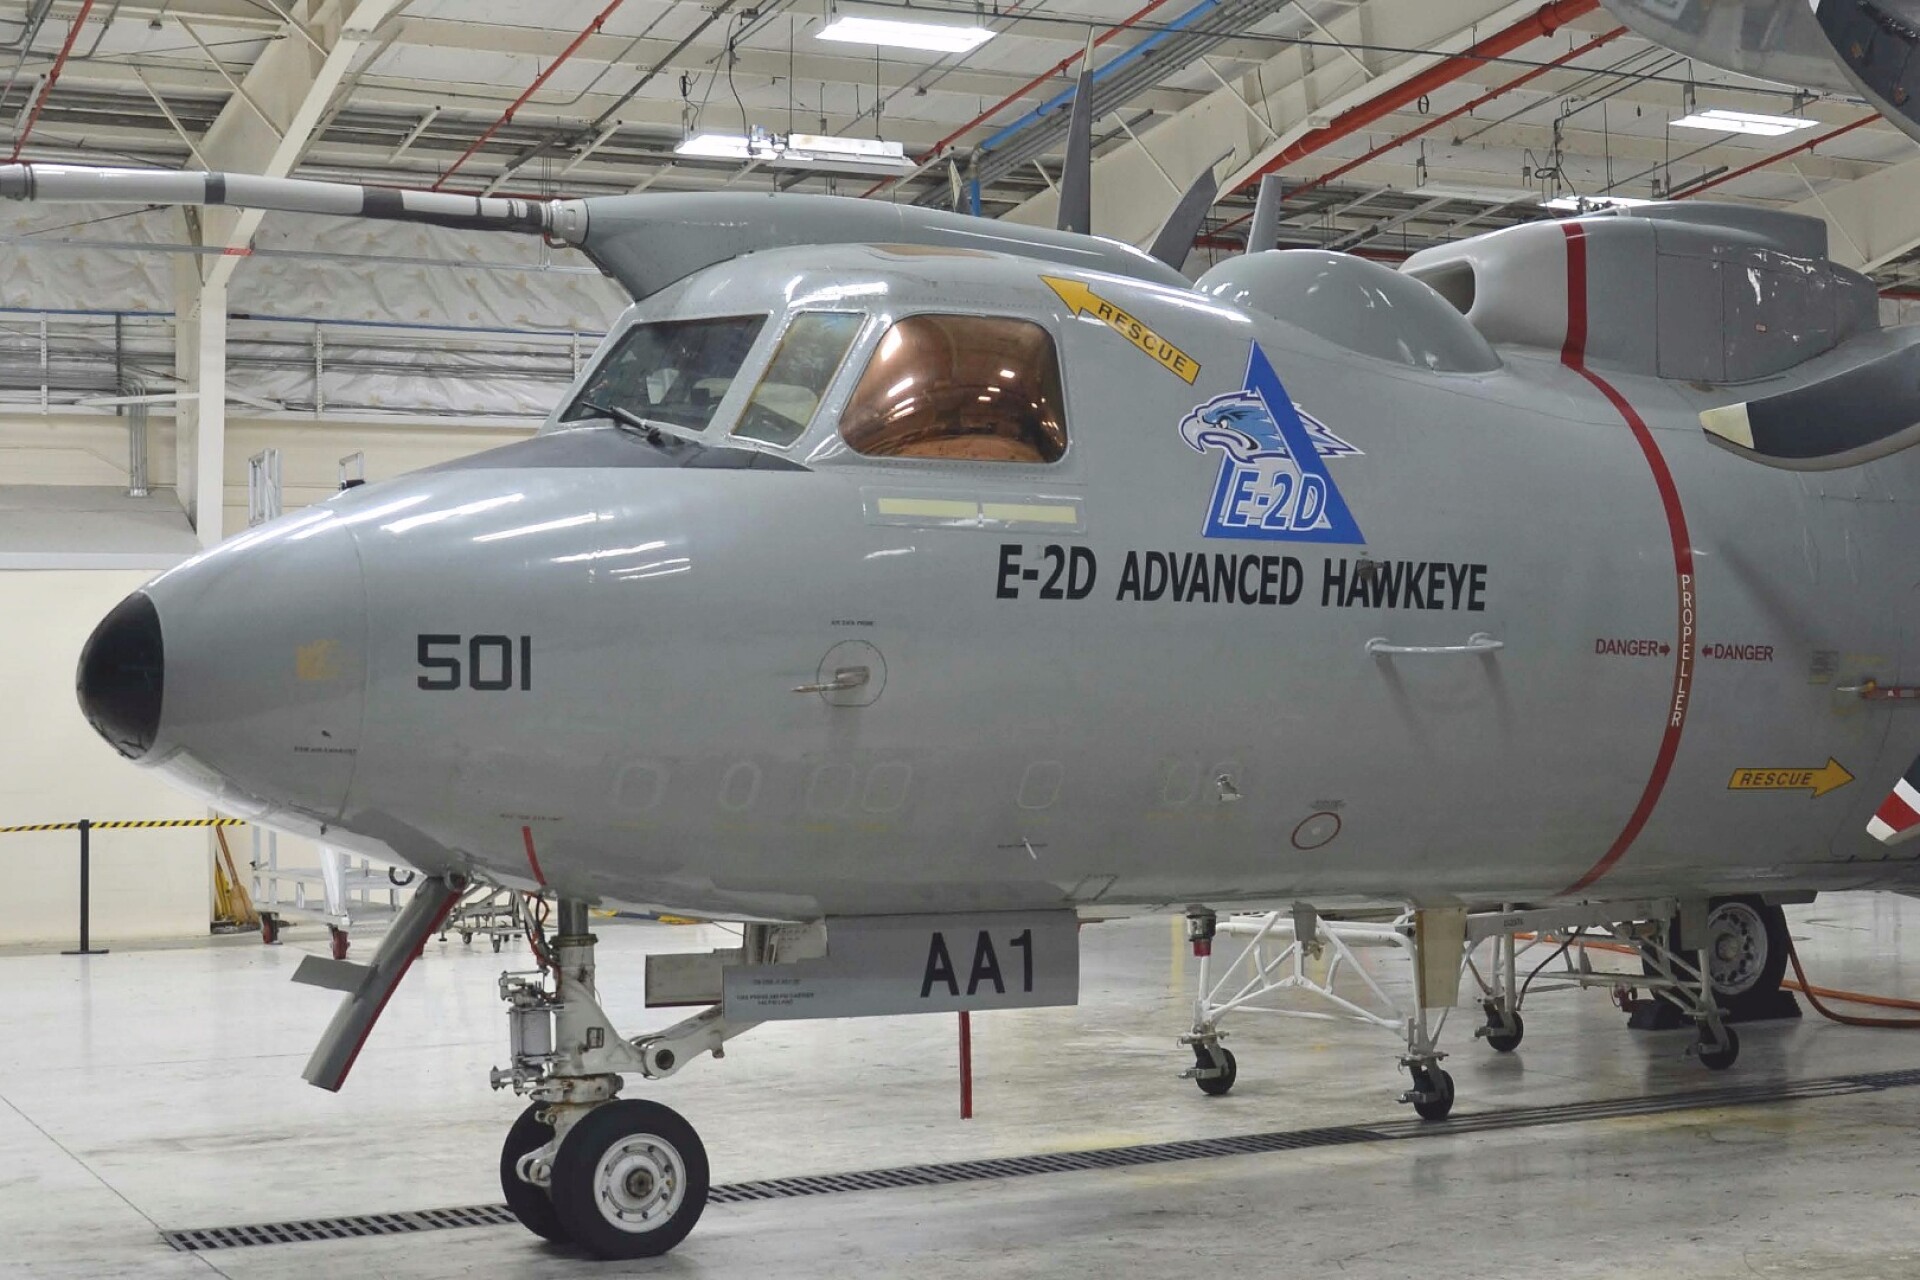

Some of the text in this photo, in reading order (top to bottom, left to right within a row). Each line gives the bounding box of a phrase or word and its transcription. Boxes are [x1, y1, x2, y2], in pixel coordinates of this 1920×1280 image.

[1098, 302, 1188, 374] RESCUE
[1222, 468, 1327, 531] E-2D
[996, 544, 1488, 611] E-2D ADVANCED HAWKEYE
[417, 634, 531, 691] 501
[1595, 638, 1658, 656] DANGER
[1670, 574, 1693, 727] PROPELLER
[1714, 643, 1774, 662] DANGER
[1740, 772, 1813, 786] RESCUE
[920, 929, 1033, 998] AA1
